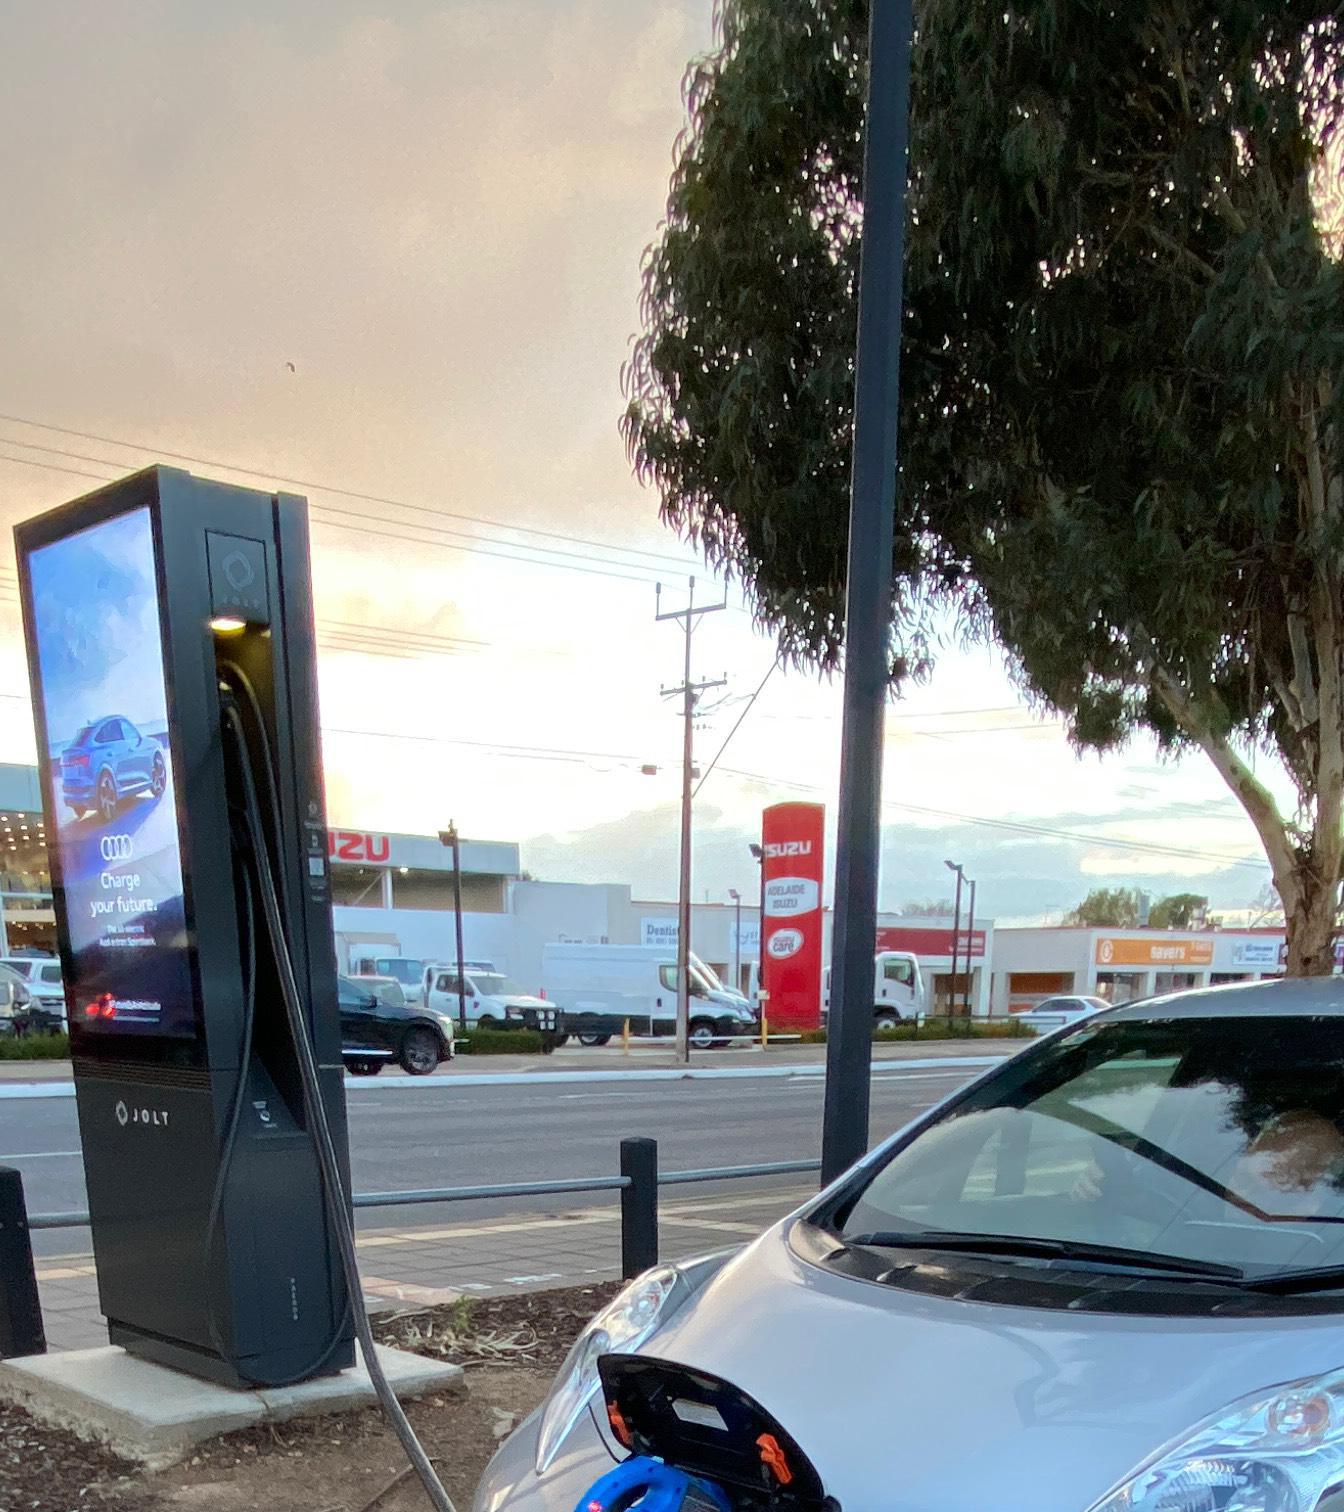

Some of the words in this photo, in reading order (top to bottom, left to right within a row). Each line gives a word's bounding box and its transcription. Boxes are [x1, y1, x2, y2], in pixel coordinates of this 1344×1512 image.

[764, 840, 813, 858] ISUZU
[100, 872, 141, 892] Charge
[89, 900, 115, 918] your
[116, 895, 158, 913] future.
[133, 1108, 169, 1125] JOLT
